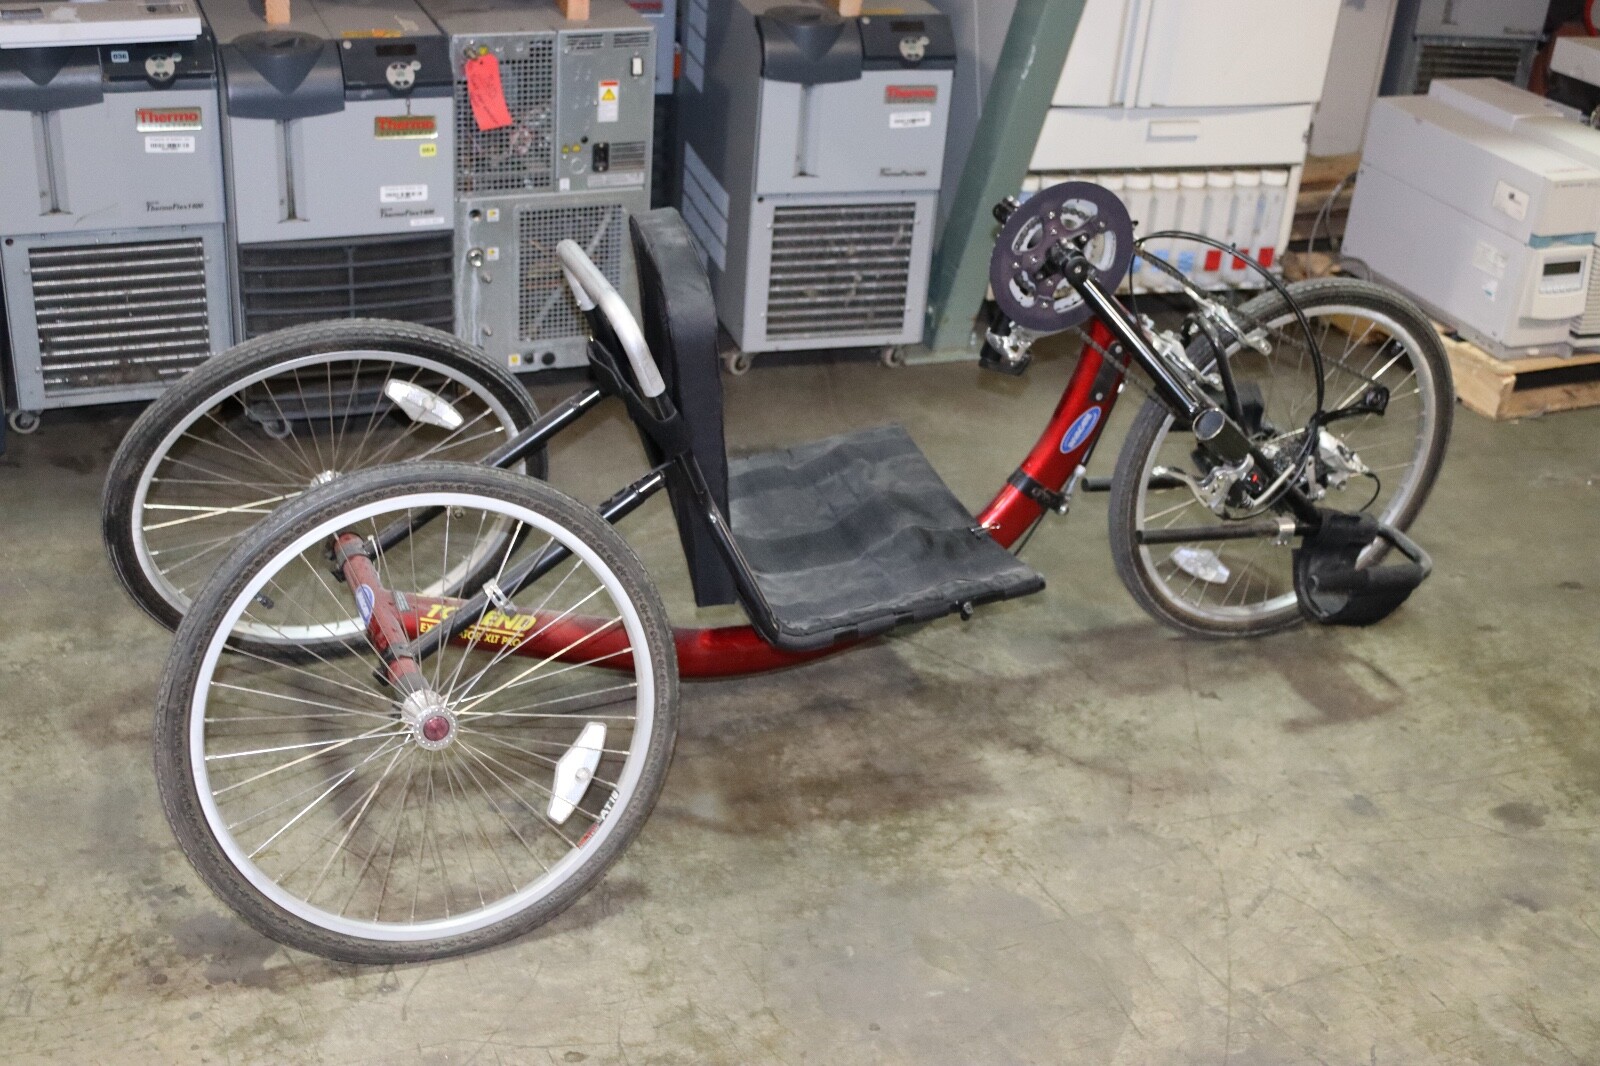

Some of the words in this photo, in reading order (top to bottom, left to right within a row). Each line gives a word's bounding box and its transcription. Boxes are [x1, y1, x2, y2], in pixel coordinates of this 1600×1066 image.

[138, 110, 199, 123] Thermo
[378, 117, 435, 130] Thermo
[481, 610, 537, 632] END
[484, 633, 501, 644] XLT
